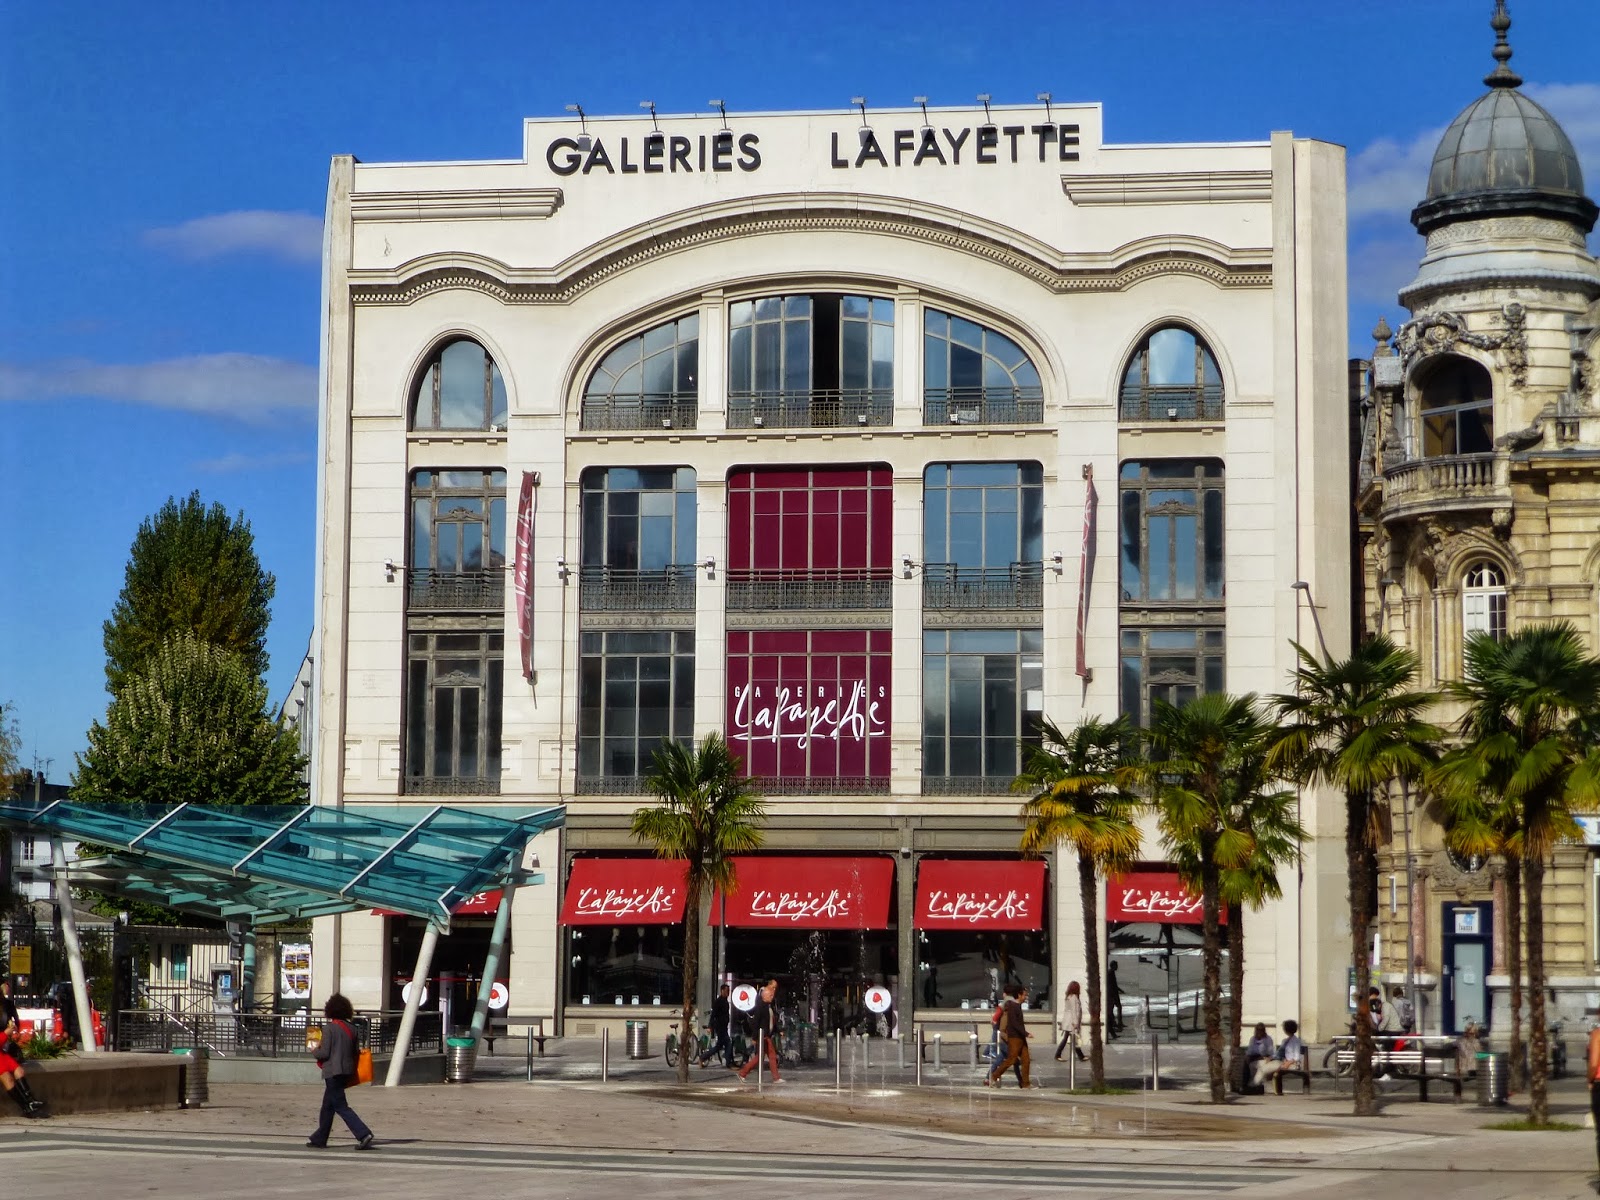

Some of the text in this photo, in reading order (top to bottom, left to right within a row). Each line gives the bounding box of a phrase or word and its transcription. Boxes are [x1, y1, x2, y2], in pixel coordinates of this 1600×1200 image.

[546, 124, 1080, 176] GALERIES LAFAYETTE
[734, 686, 885, 698] GALERIES
[733, 680, 885, 749] Lafayette
[575, 886, 673, 917] Lafayette
[749, 889, 849, 921] Lafayette
[927, 890, 1028, 922] Lafayette
